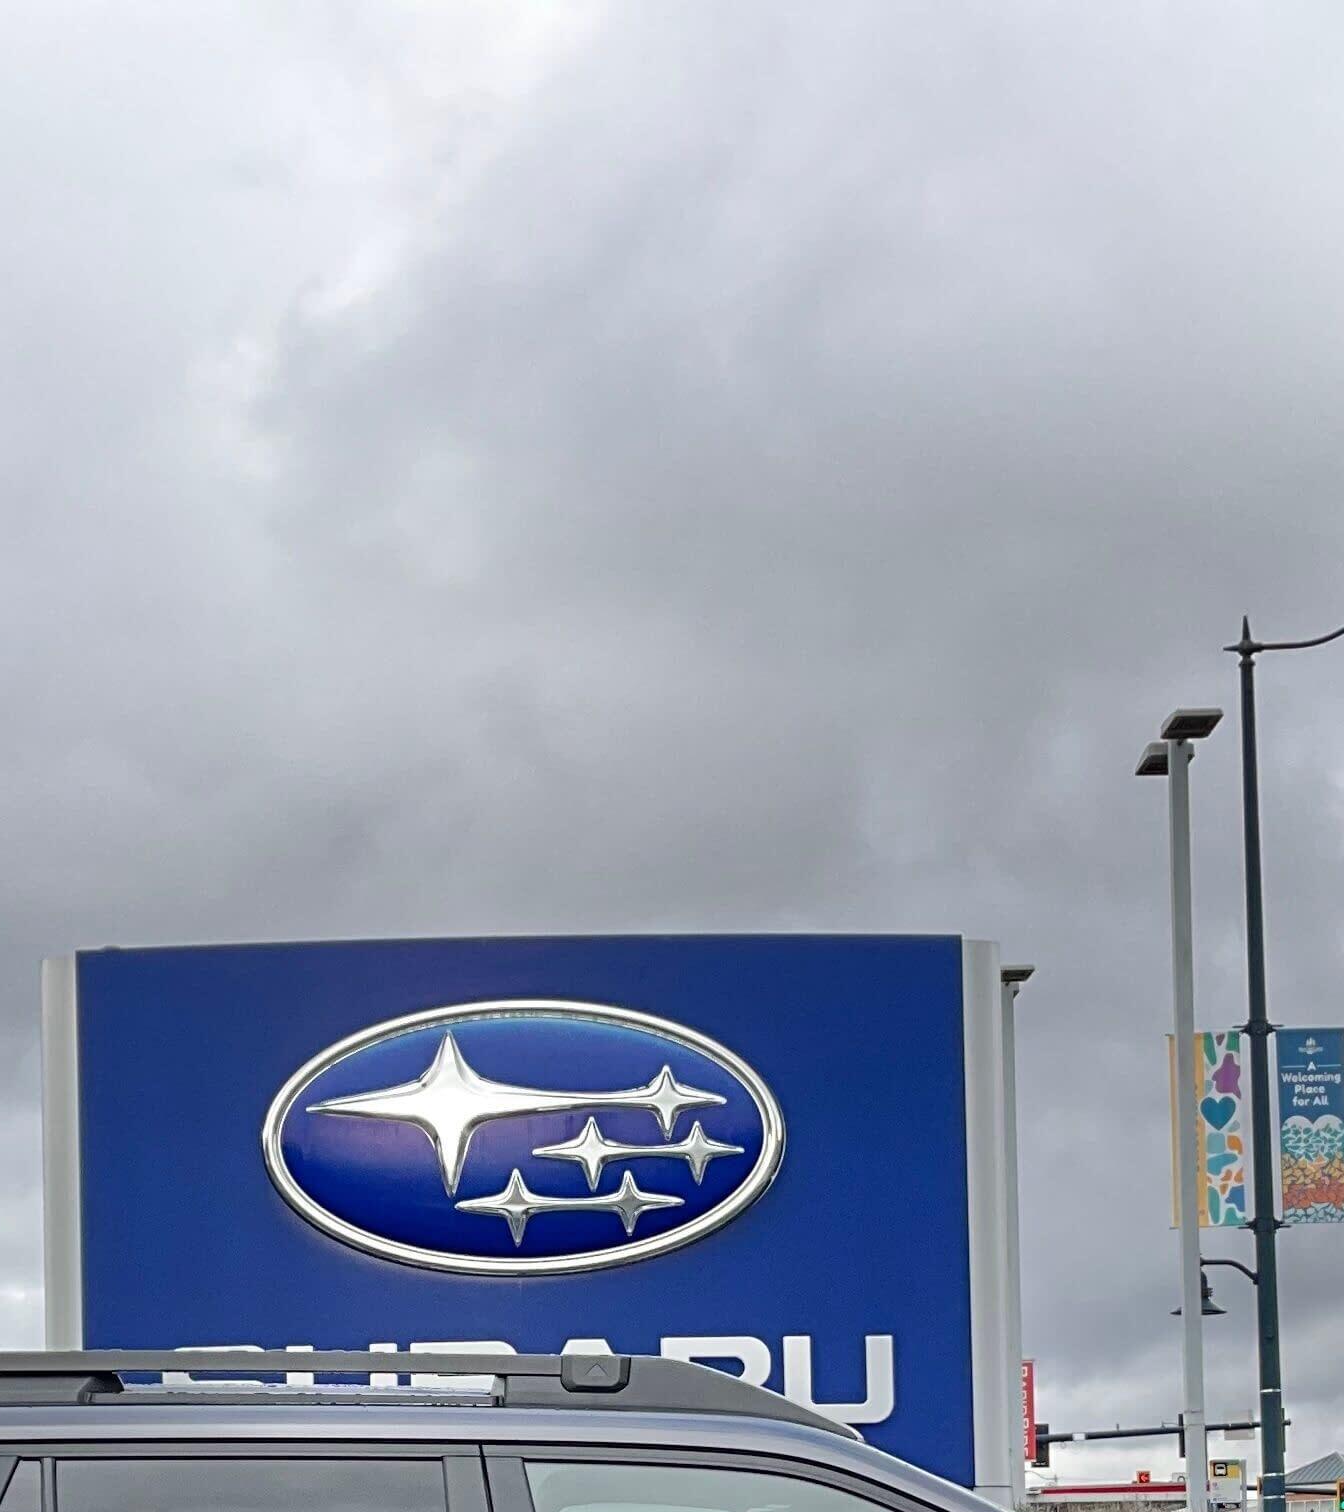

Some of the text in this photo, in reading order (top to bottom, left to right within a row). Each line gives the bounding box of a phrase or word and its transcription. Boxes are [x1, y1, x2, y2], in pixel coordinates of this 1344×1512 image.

[1307, 1061, 1316, 1071] A
[1281, 1072, 1341, 1084] Welcoming
[1294, 1084, 1325, 1094] Place
[1293, 1095, 1329, 1107] for All
